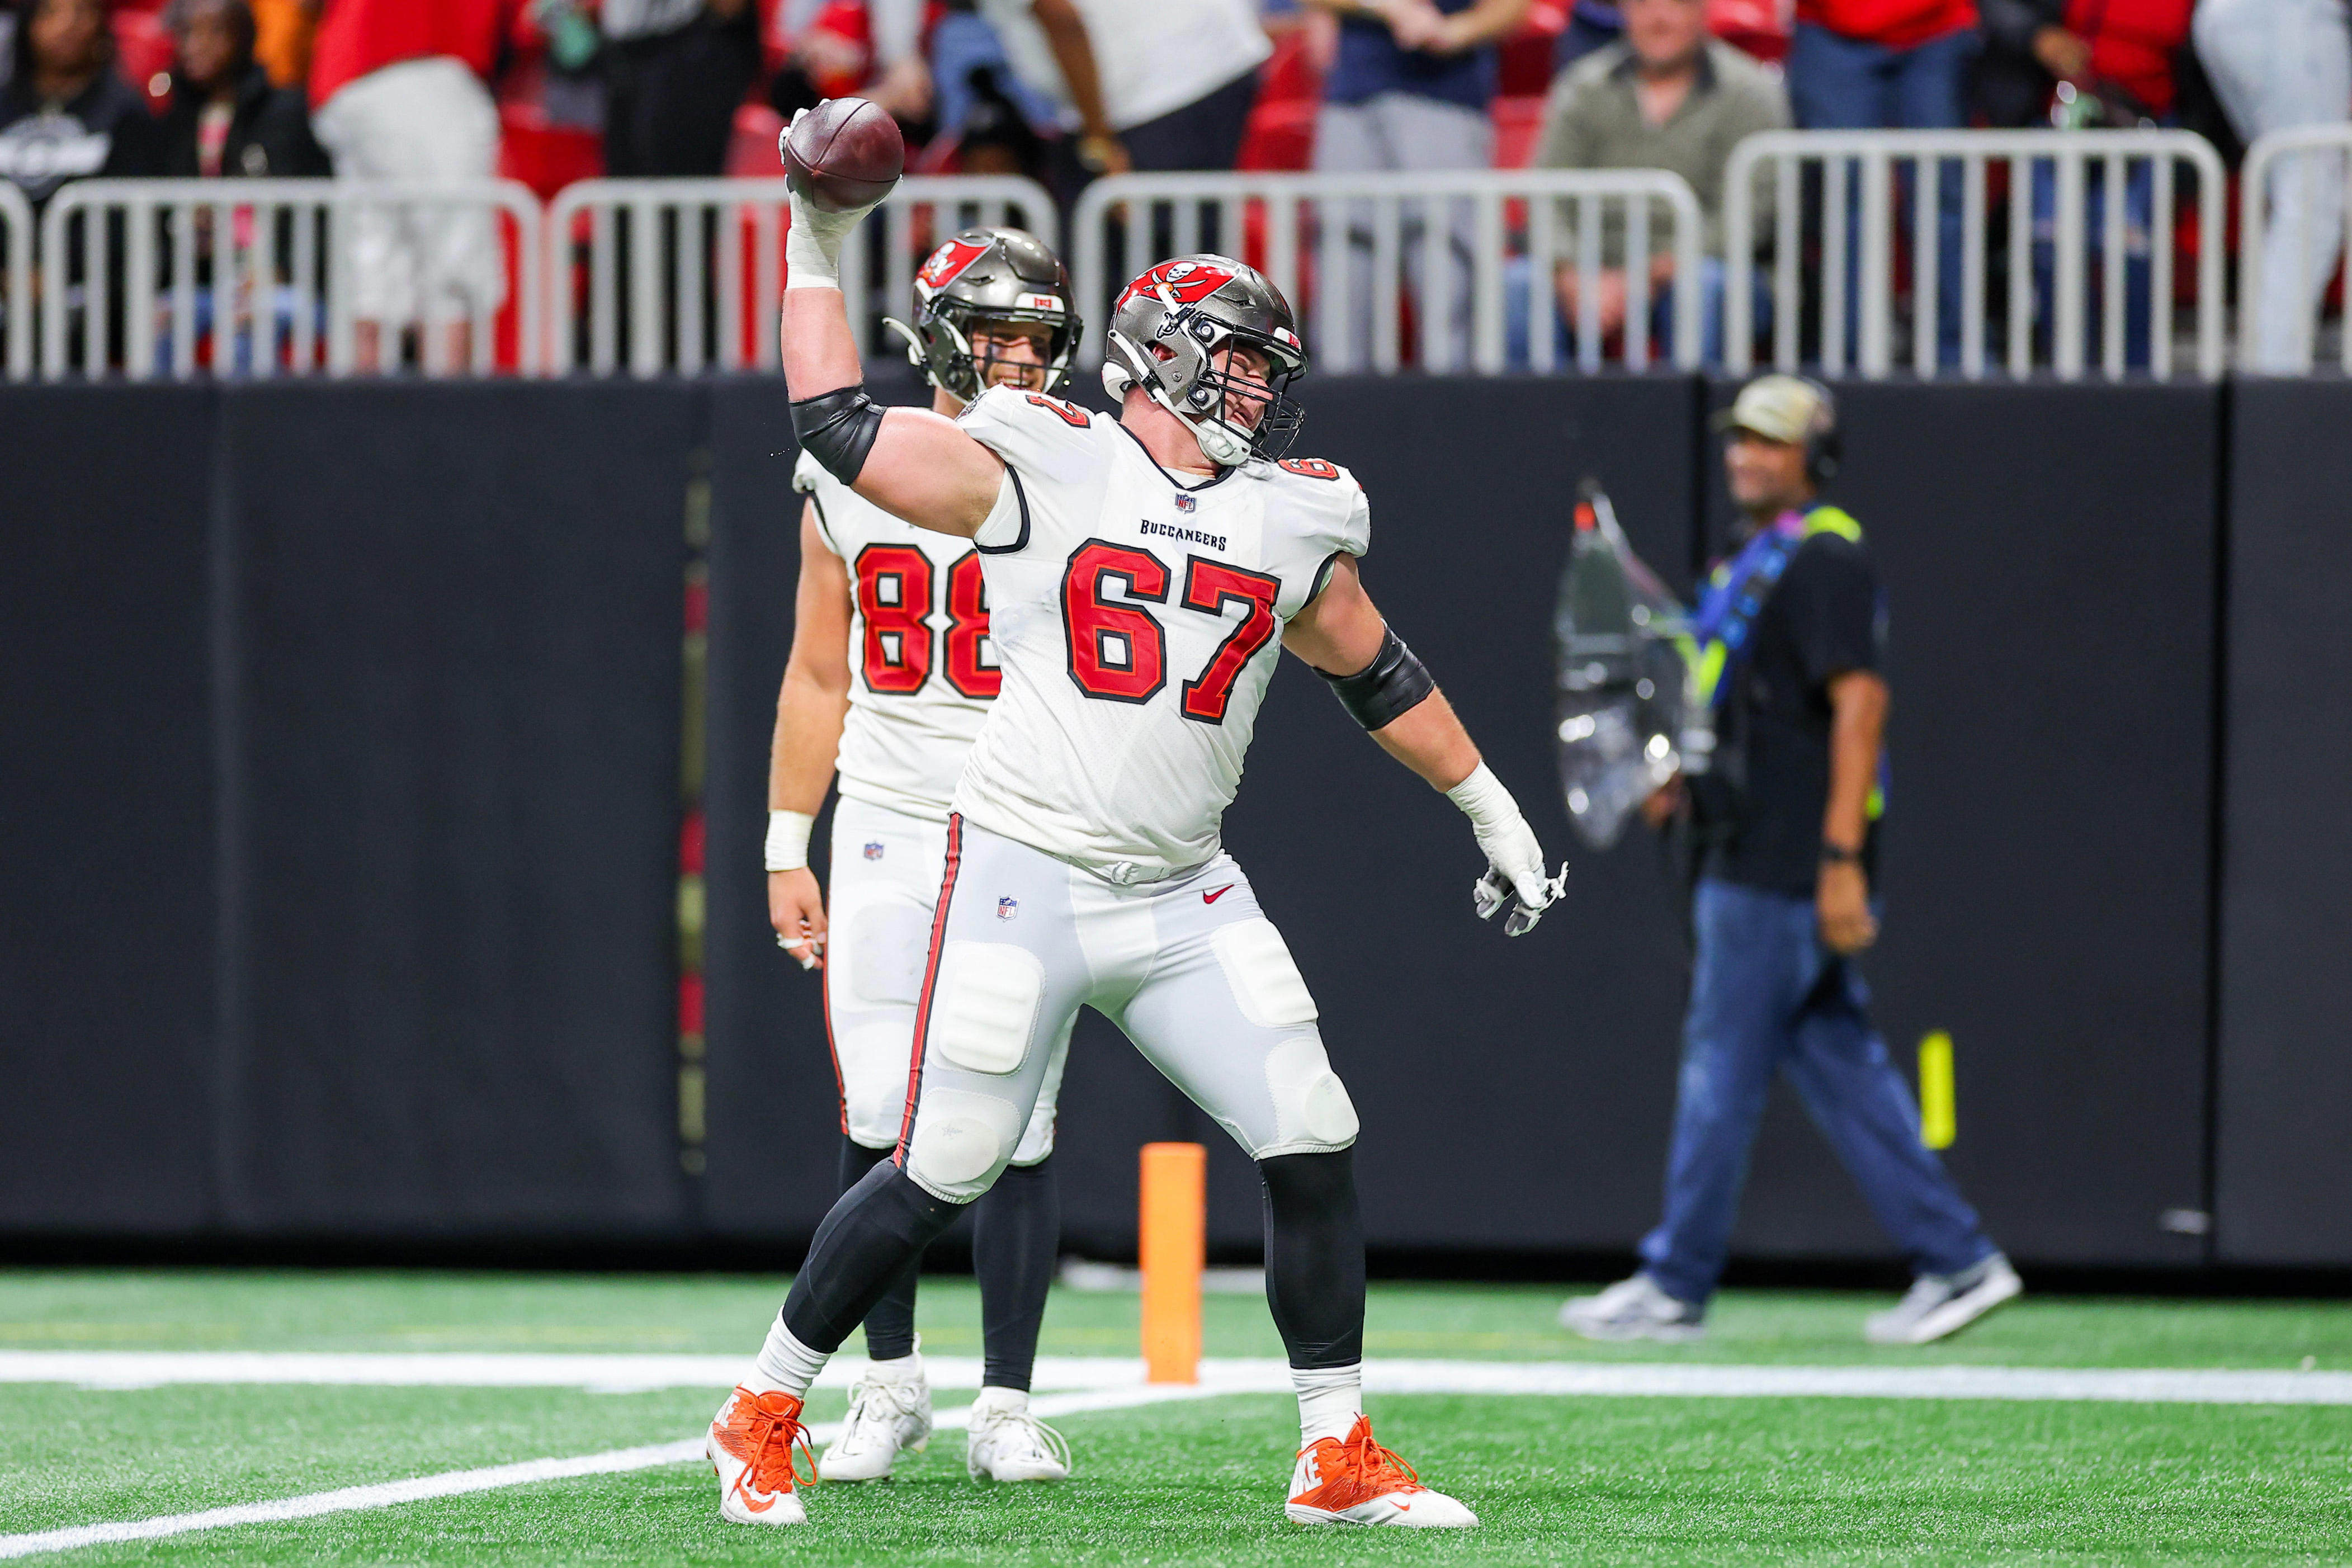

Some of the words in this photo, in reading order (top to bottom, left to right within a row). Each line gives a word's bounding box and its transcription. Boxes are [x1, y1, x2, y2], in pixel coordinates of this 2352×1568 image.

[1178, 499, 1193, 510] NFL
[1140, 519, 1227, 551] BUCCANEERS
[854, 542, 1003, 699] 88
[1060, 538, 1282, 725] 67
[998, 905, 1013, 917] NFL
